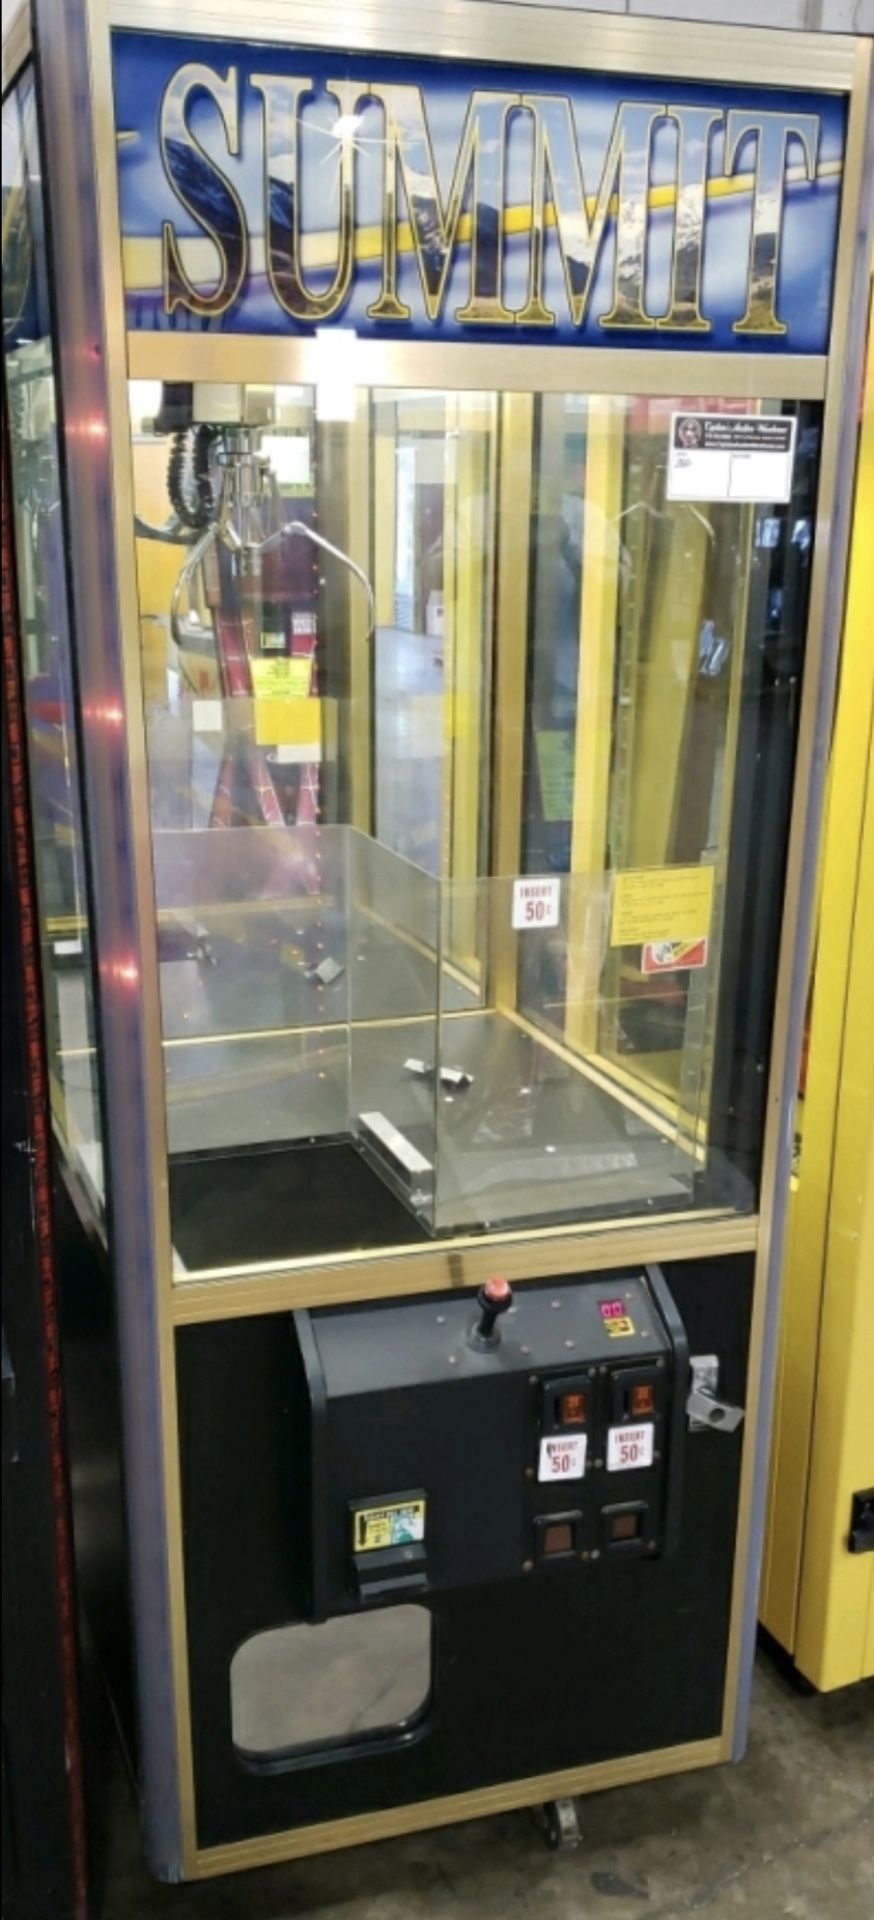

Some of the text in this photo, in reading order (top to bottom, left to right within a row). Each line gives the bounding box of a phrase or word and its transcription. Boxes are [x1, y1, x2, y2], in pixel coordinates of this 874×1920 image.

[158, 62, 820, 336] SUMMIT
[520, 885, 552, 898] INSERT
[615, 1430, 645, 1444] INSERT
